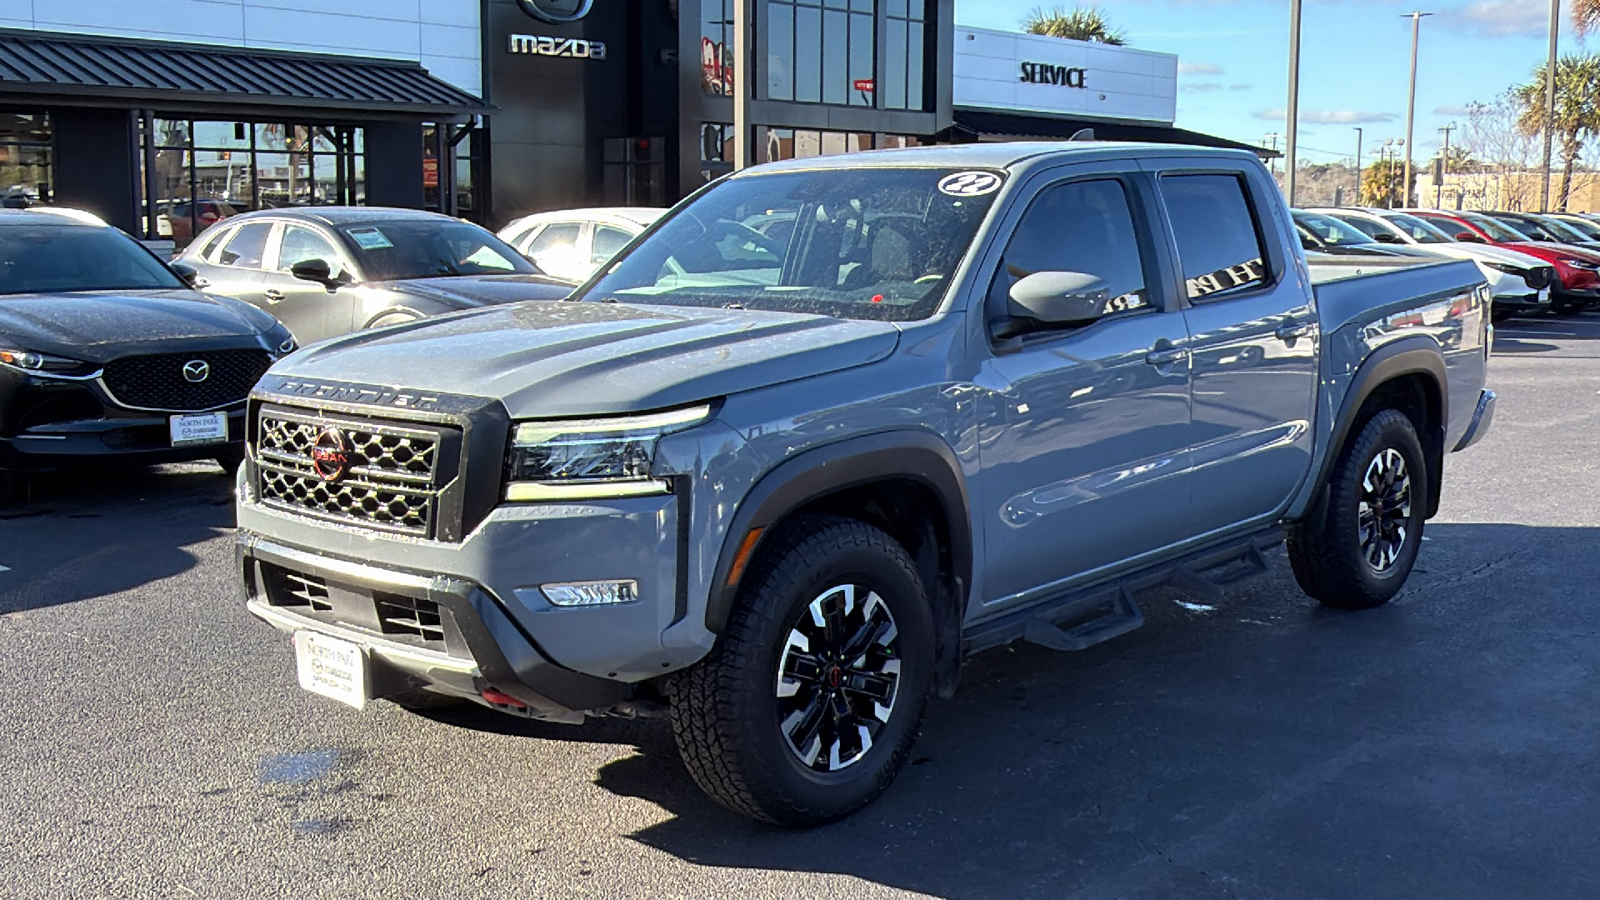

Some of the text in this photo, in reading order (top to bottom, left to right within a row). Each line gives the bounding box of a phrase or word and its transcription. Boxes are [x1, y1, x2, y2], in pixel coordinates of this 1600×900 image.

[1020, 61, 1088, 88] SERVICE
[944, 174, 994, 193] 22
[278, 381, 438, 408] FRONTIER
[311, 447, 347, 463] ISSAN
